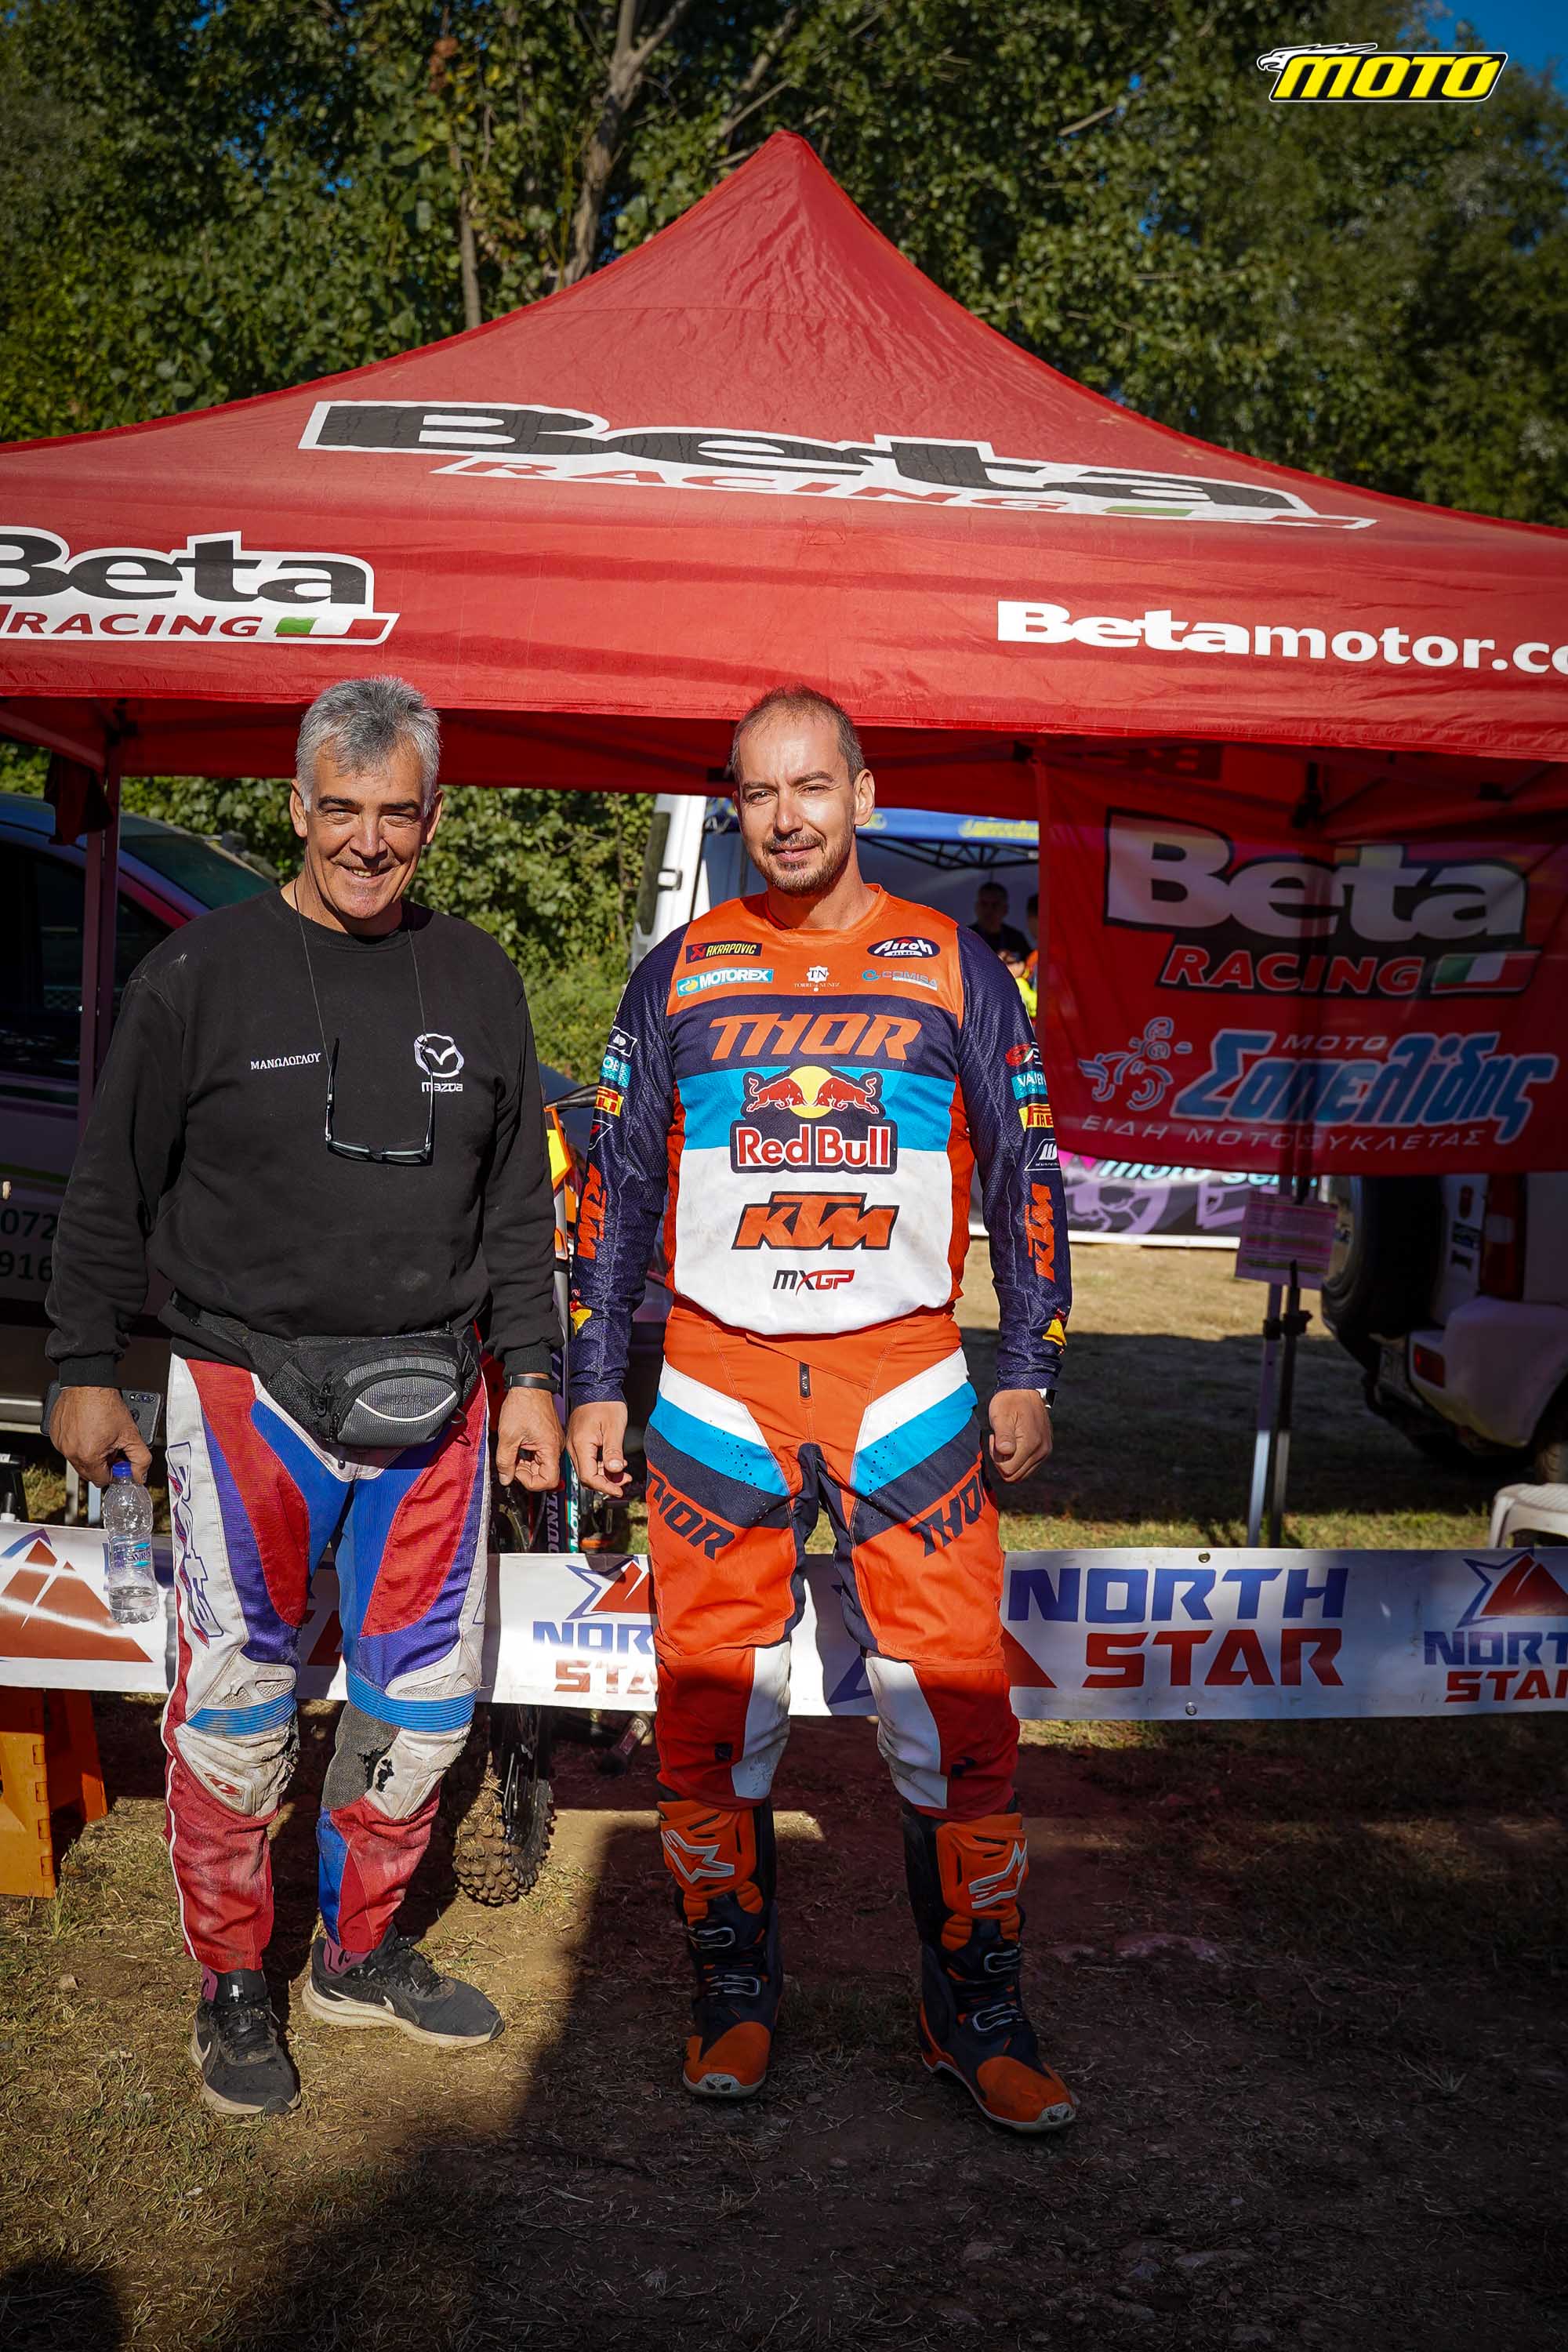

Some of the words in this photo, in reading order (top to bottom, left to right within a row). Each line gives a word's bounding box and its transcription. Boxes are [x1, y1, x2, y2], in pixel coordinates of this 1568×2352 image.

[310, 402, 1301, 512] Beta
[453, 461, 1069, 510] RACING
[6, 612, 263, 638] RACING
[1106, 812, 1523, 942] Beta
[874, 939, 933, 955] Airoh
[1160, 946, 1425, 995] RACING
[699, 969, 770, 989] MOTOREX
[708, 1014, 922, 1061] THOR
[736, 1124, 809, 1166] Red
[815, 1126, 892, 1167] Bull
[577, 1163, 606, 1260] KTM
[733, 1192, 897, 1250] KTM
[1024, 1183, 1055, 1283] KTM
[773, 1269, 855, 1295] MXGP
[1007, 1567, 1348, 1624] NORTH
[1081, 1628, 1345, 1690] STAR
